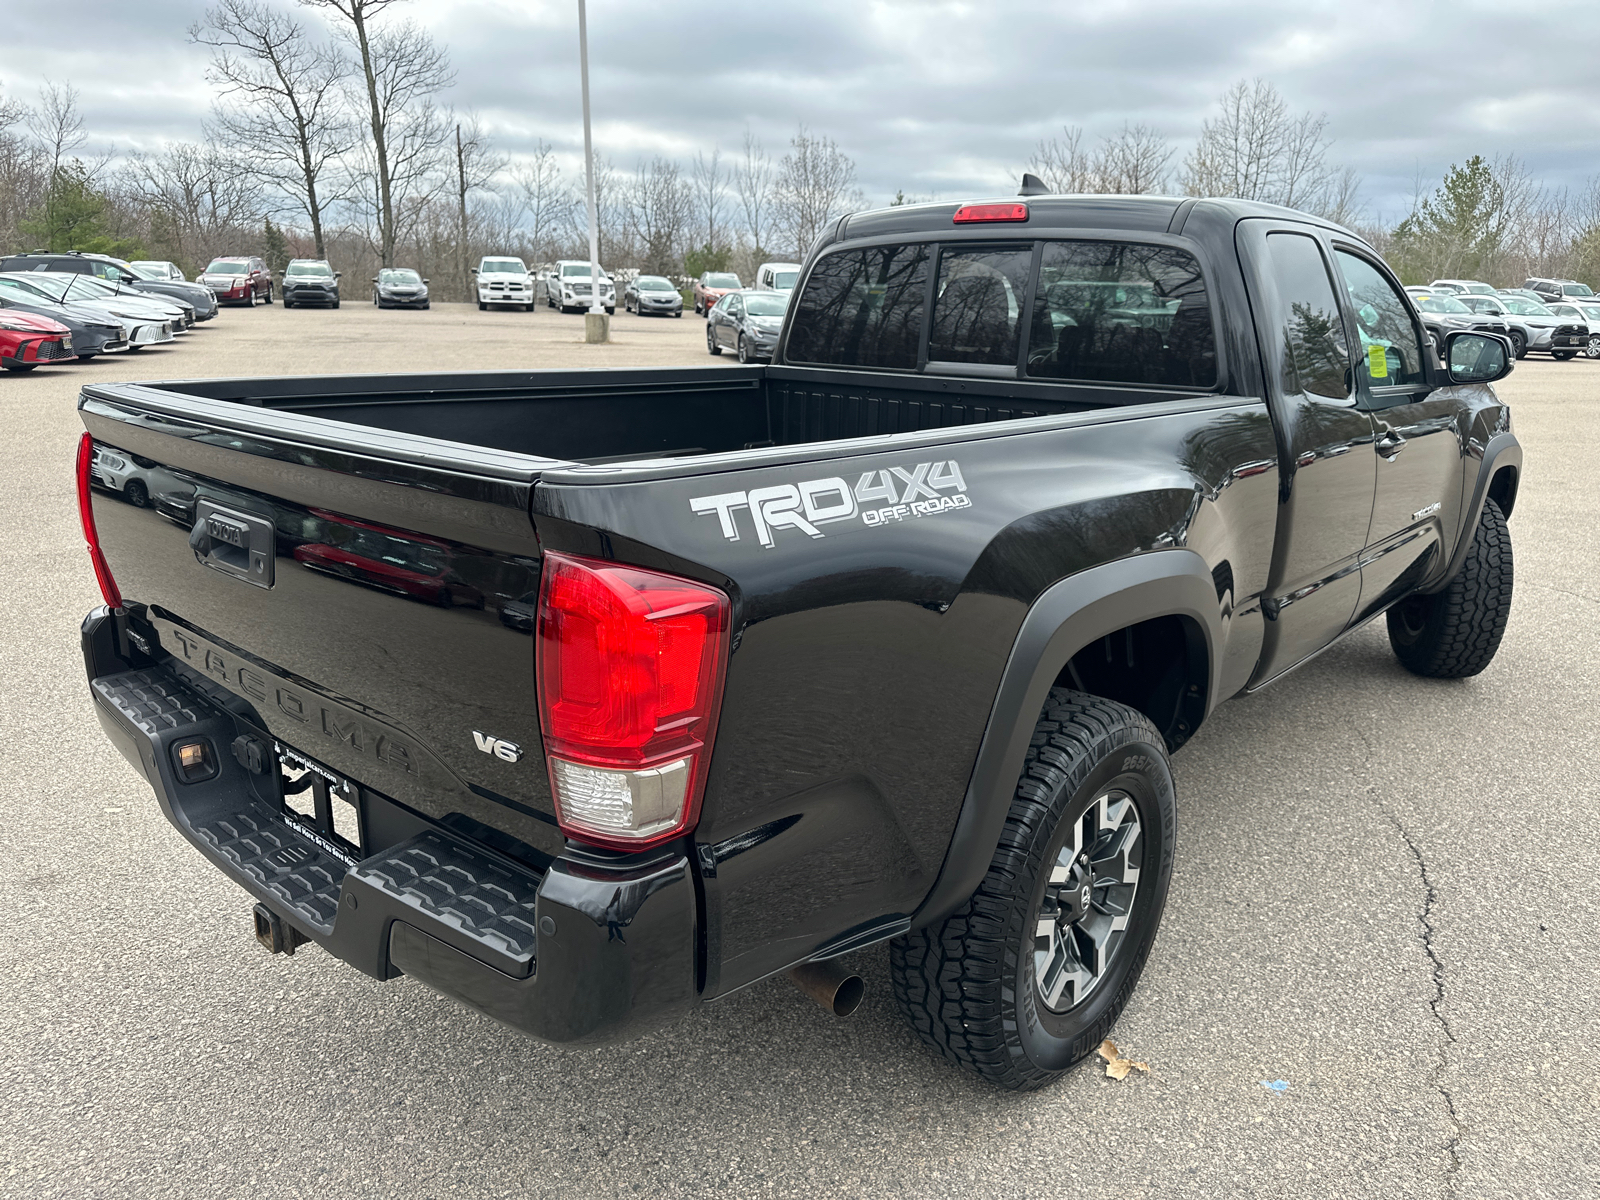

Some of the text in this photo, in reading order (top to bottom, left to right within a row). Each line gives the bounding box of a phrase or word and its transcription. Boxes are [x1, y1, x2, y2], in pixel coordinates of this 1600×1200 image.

[689, 460, 967, 549] TRD 4X4
[862, 494, 972, 527] OFF ROAD
[208, 519, 241, 543] TOYOTA
[174, 630, 421, 778] TACOMA
[472, 730, 523, 762] V6
[286, 748, 337, 783] Imperialcars.com
